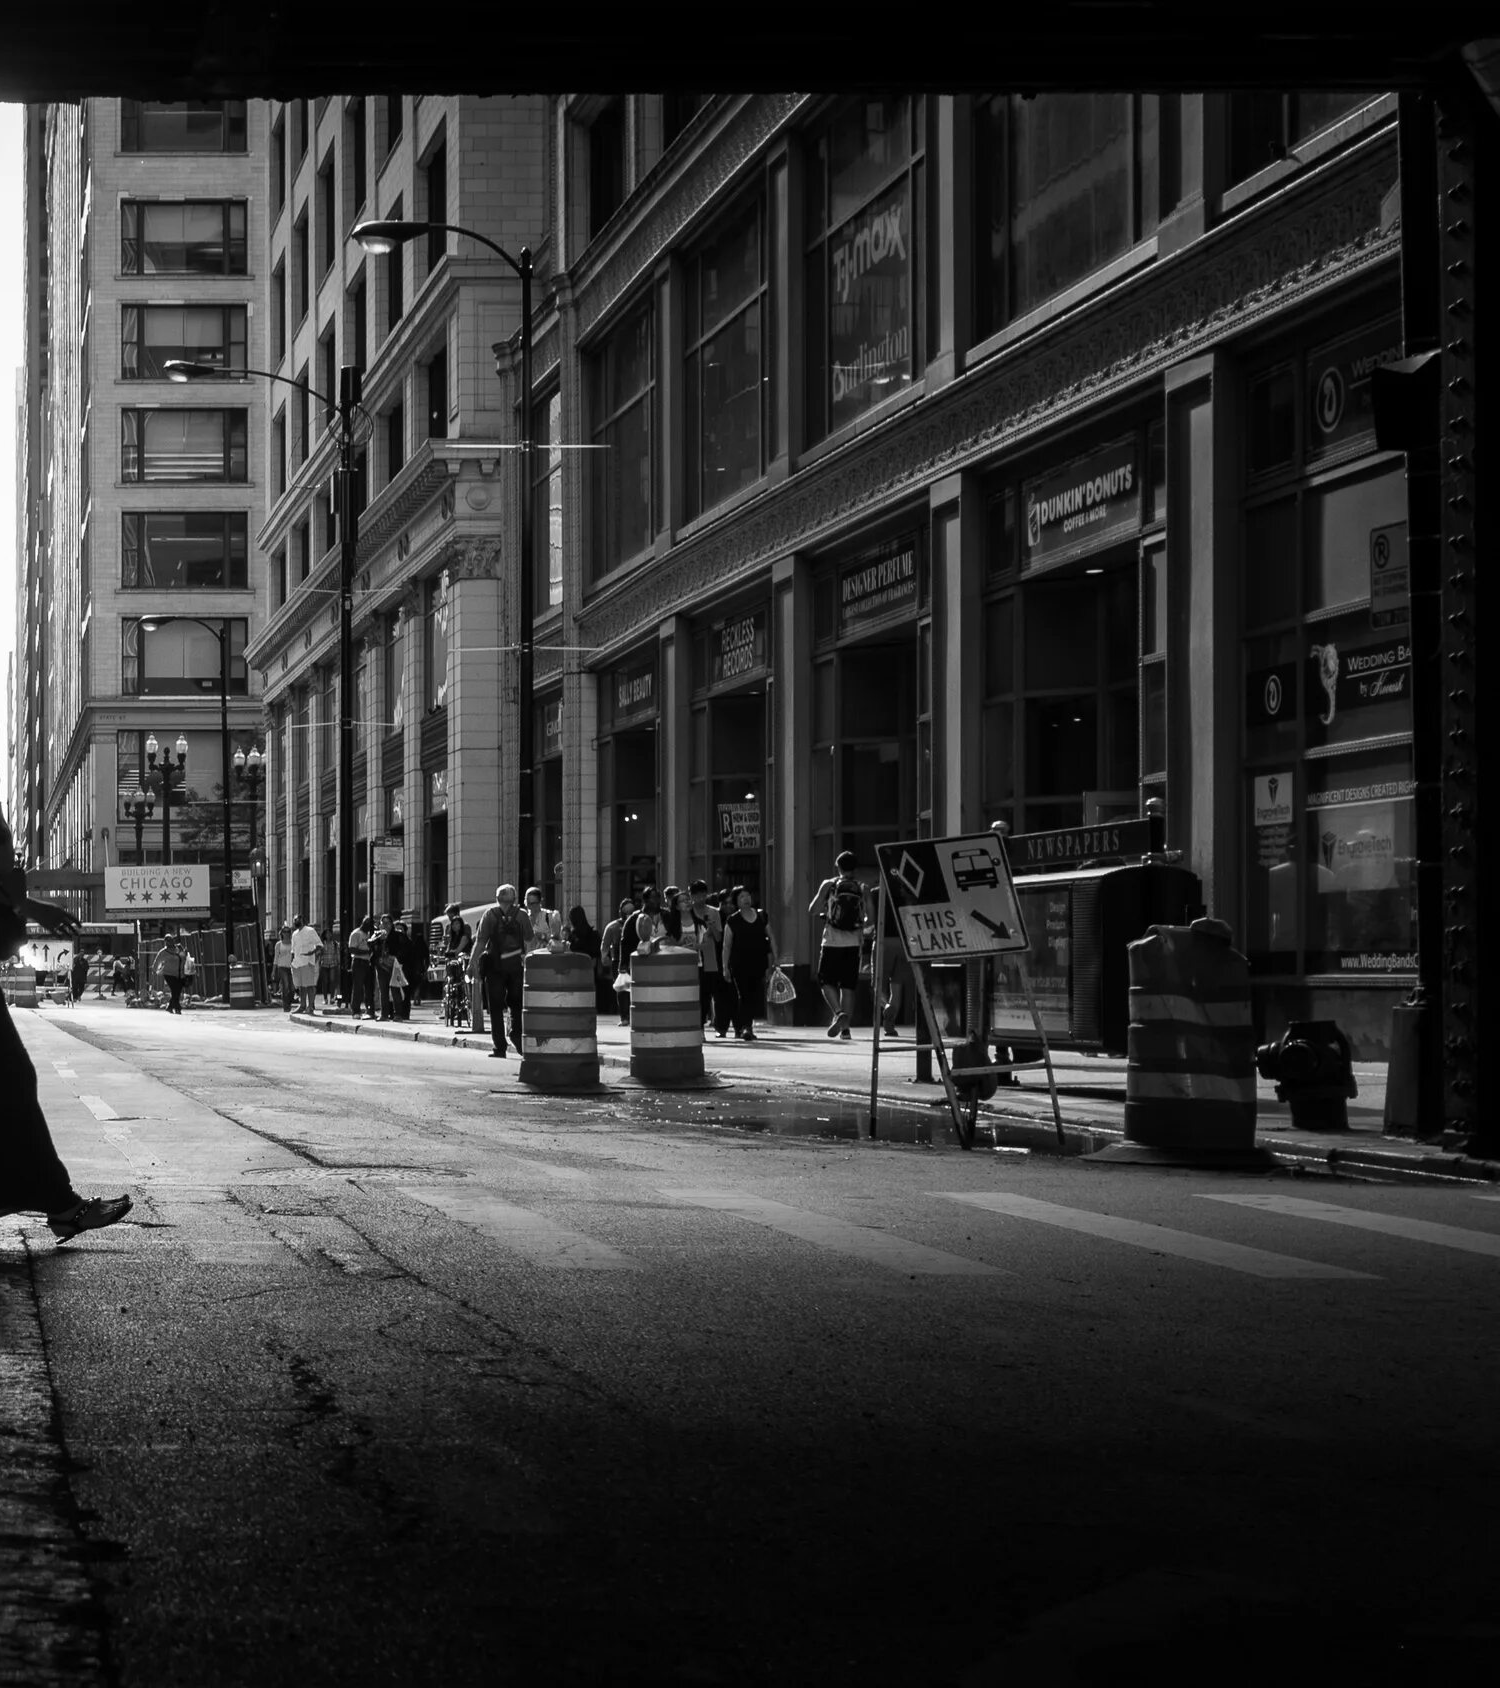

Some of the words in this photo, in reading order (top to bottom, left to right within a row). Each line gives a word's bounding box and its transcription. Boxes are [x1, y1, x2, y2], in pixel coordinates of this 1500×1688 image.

[833, 326, 907, 403] Burlington
[1041, 483, 1085, 525] DUNKIN'
[1086, 463, 1132, 505] DONUTS
[1063, 512, 1085, 534] COFFEE
[1090, 504, 1107, 523] MORE
[843, 567, 877, 603] DESIGNER
[878, 550, 914, 589] PERFUME
[722, 616, 754, 653] RECKLESS
[723, 643, 753, 679] RECORDS
[1347, 650, 1395, 673] WEDDING
[1345, 785, 1370, 801] DESIGNS
[1371, 782, 1398, 798] CREATED
[1027, 829, 1119, 860] NEWSPAPERS
[120, 876, 193, 889] CHICAGO
[121, 868, 161, 877] BUILDING
[172, 868, 191, 876] NEW
[911, 910, 956, 931] THIS
[917, 930, 967, 952] LANE
